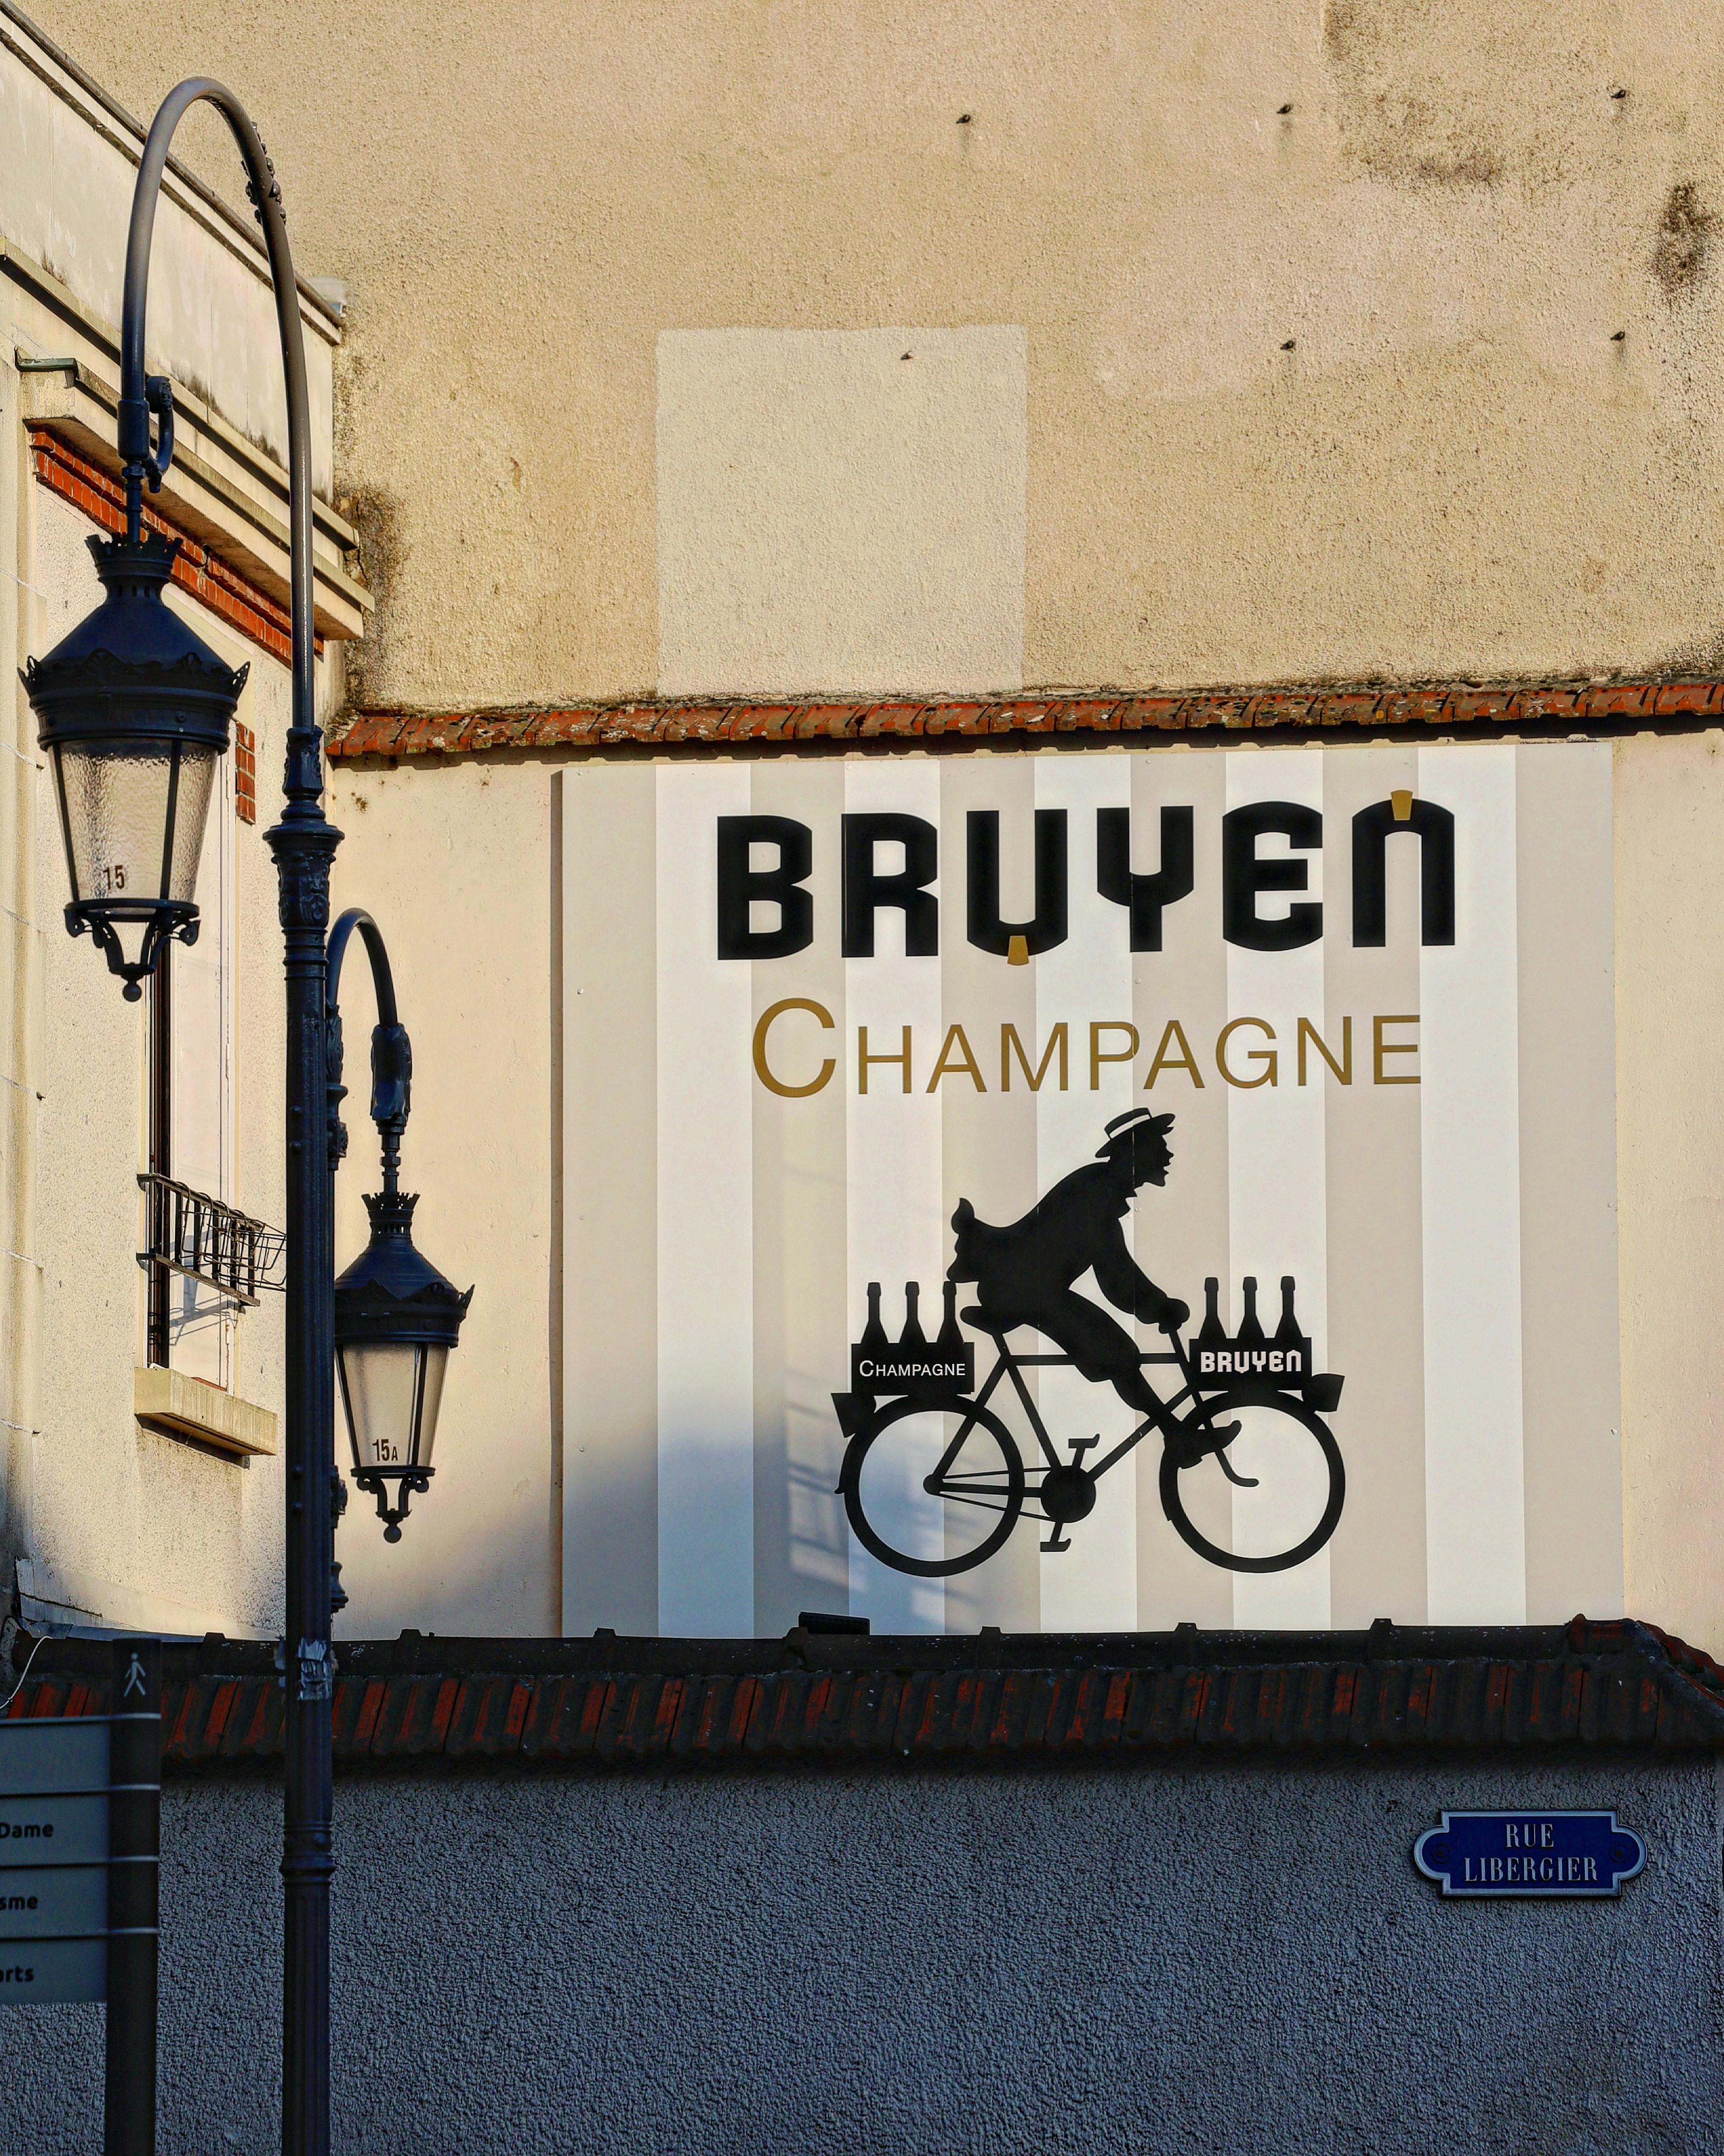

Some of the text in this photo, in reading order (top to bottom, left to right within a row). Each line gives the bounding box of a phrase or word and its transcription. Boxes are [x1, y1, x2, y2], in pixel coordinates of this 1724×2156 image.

[103, 865, 125, 890] 15
[717, 790, 1456, 966] BRUYEN
[752, 997, 1421, 1097] CHAMPAGNE
[858, 1360, 966, 1378] CHAMPAGNE
[1200, 1349, 1303, 1373] BRUYEN
[1505, 1823, 1555, 1848] RUE
[1464, 1856, 1598, 1882] LIBERGIER
